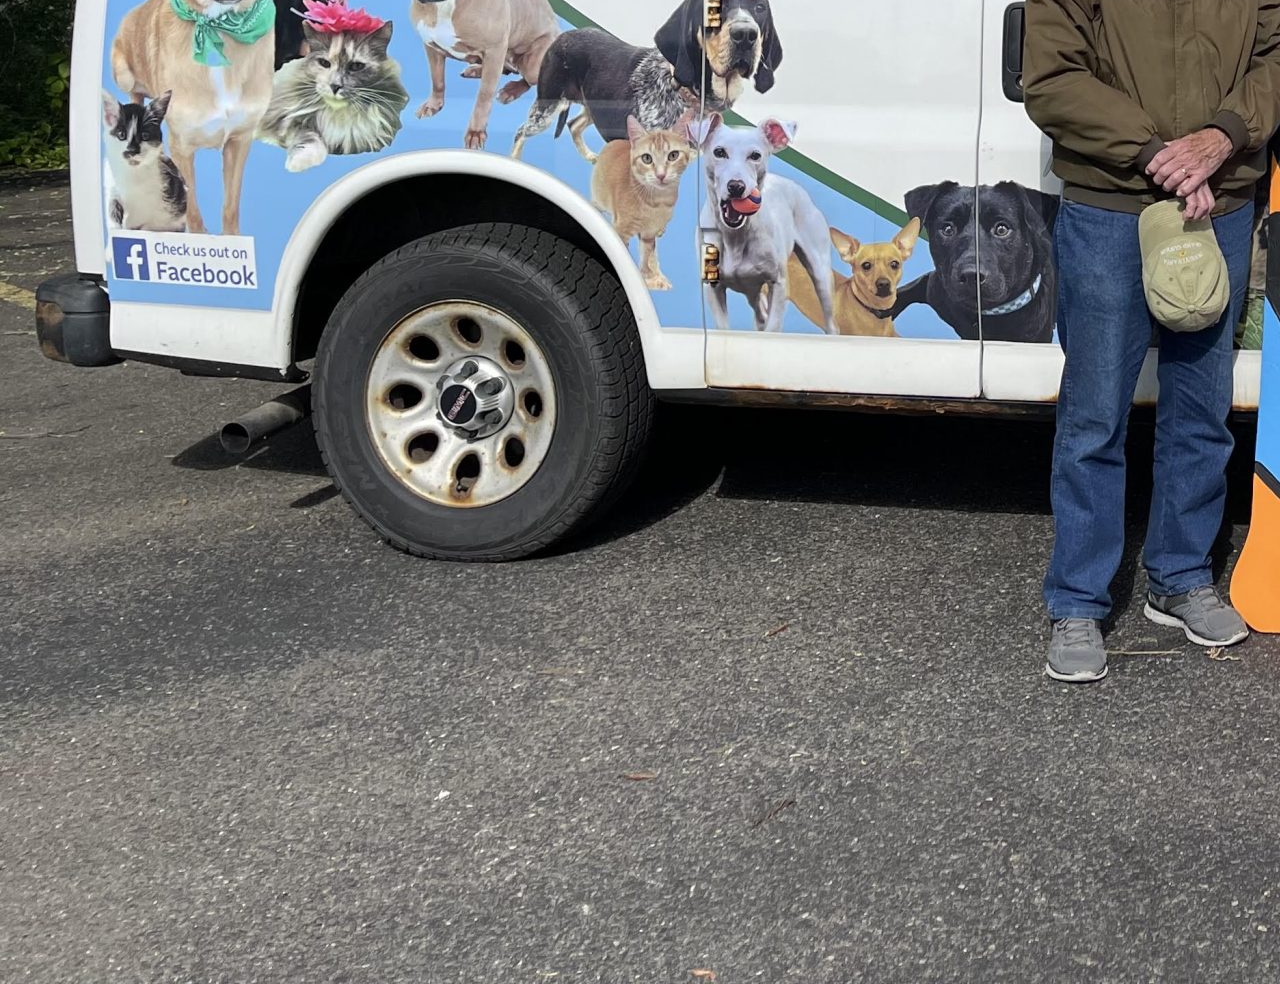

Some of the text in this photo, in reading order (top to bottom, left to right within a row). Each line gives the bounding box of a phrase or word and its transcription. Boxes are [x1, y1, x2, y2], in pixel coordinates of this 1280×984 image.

[154, 242, 248, 259] Check us out on
[156, 261, 256, 287] Facebook
